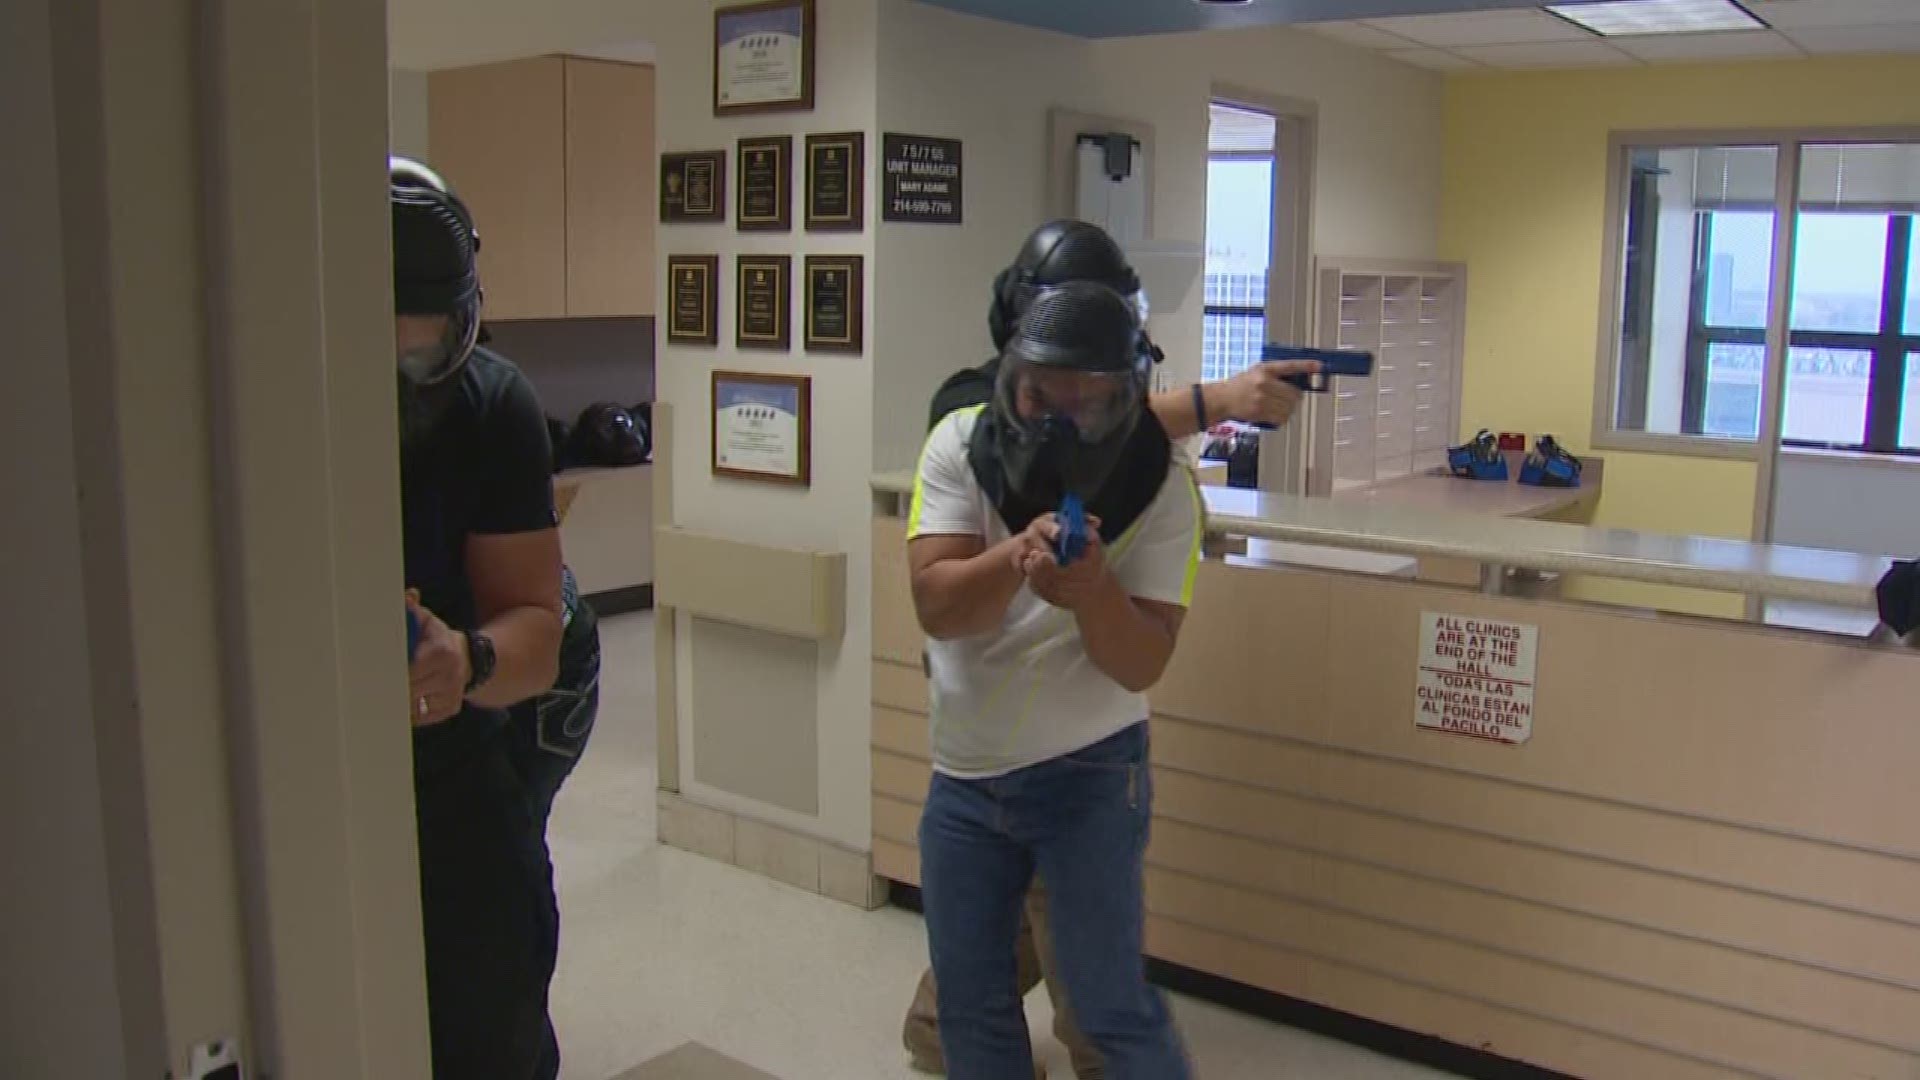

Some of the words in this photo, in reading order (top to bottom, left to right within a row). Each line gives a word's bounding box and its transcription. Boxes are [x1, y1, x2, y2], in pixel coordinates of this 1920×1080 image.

[887, 159, 909, 174] UNIT
[911, 161, 957, 177] MANAGER
[900, 180, 921, 192] MARY
[1436, 617, 1462, 631] ALL
[1465, 621, 1520, 639] CLINICS
[1438, 631, 1465, 645] ARE
[1469, 635, 1487, 648] AT
[1491, 639, 1518, 654] THE
[1435, 645, 1463, 658] END
[1467, 649, 1486, 661] OF
[1491, 652, 1517, 666] THE
[1456, 661, 1491, 676] HALL
[1437, 673, 1482, 691] TODAS
[1486, 682, 1514, 697] LAS
[1417, 686, 1480, 707] CLINICAS
[1484, 697, 1530, 715] ESTAN
[1422, 701, 1439, 713] AL
[1443, 703, 1491, 722] FONDO
[1495, 713, 1522, 728] DEL
